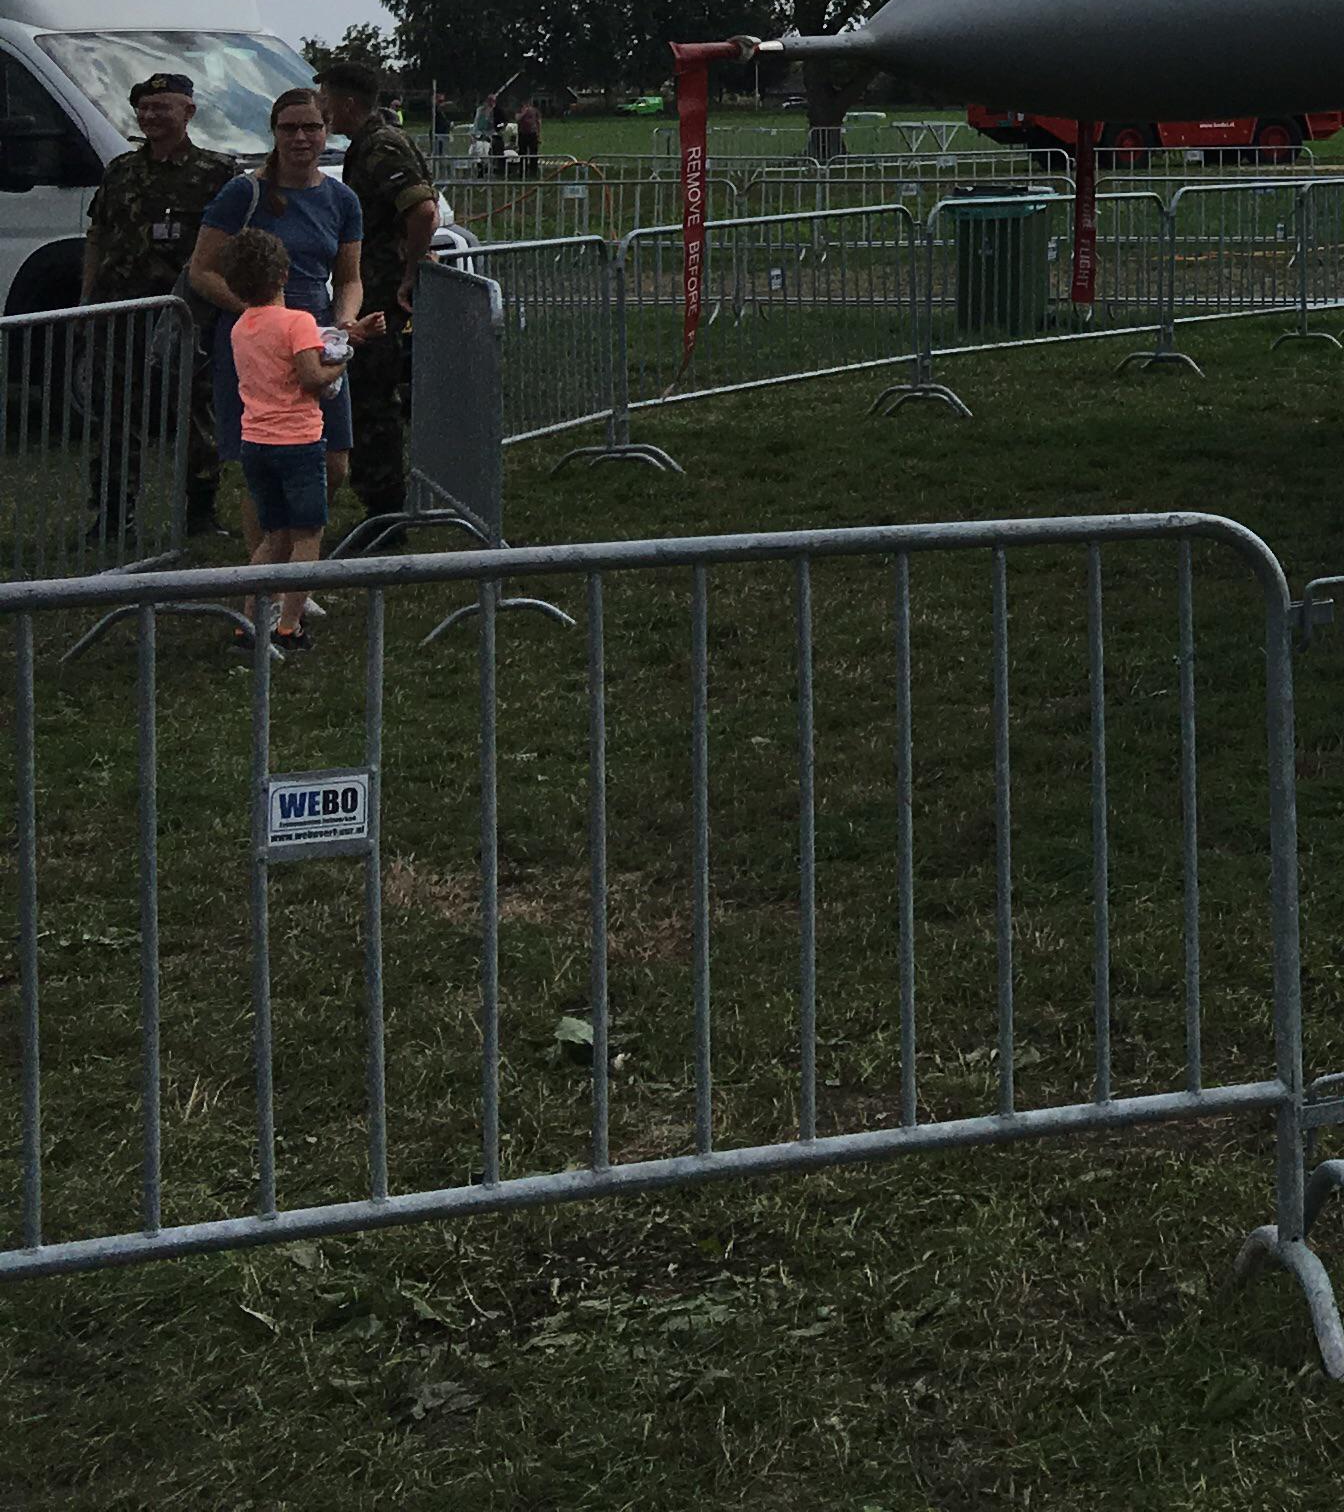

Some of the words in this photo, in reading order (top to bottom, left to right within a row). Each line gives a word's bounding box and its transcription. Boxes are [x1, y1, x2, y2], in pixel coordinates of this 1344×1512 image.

[686, 145, 701, 228] REMOVE
[687, 240, 700, 317] BEFORE
[279, 787, 359, 819] WEBO
